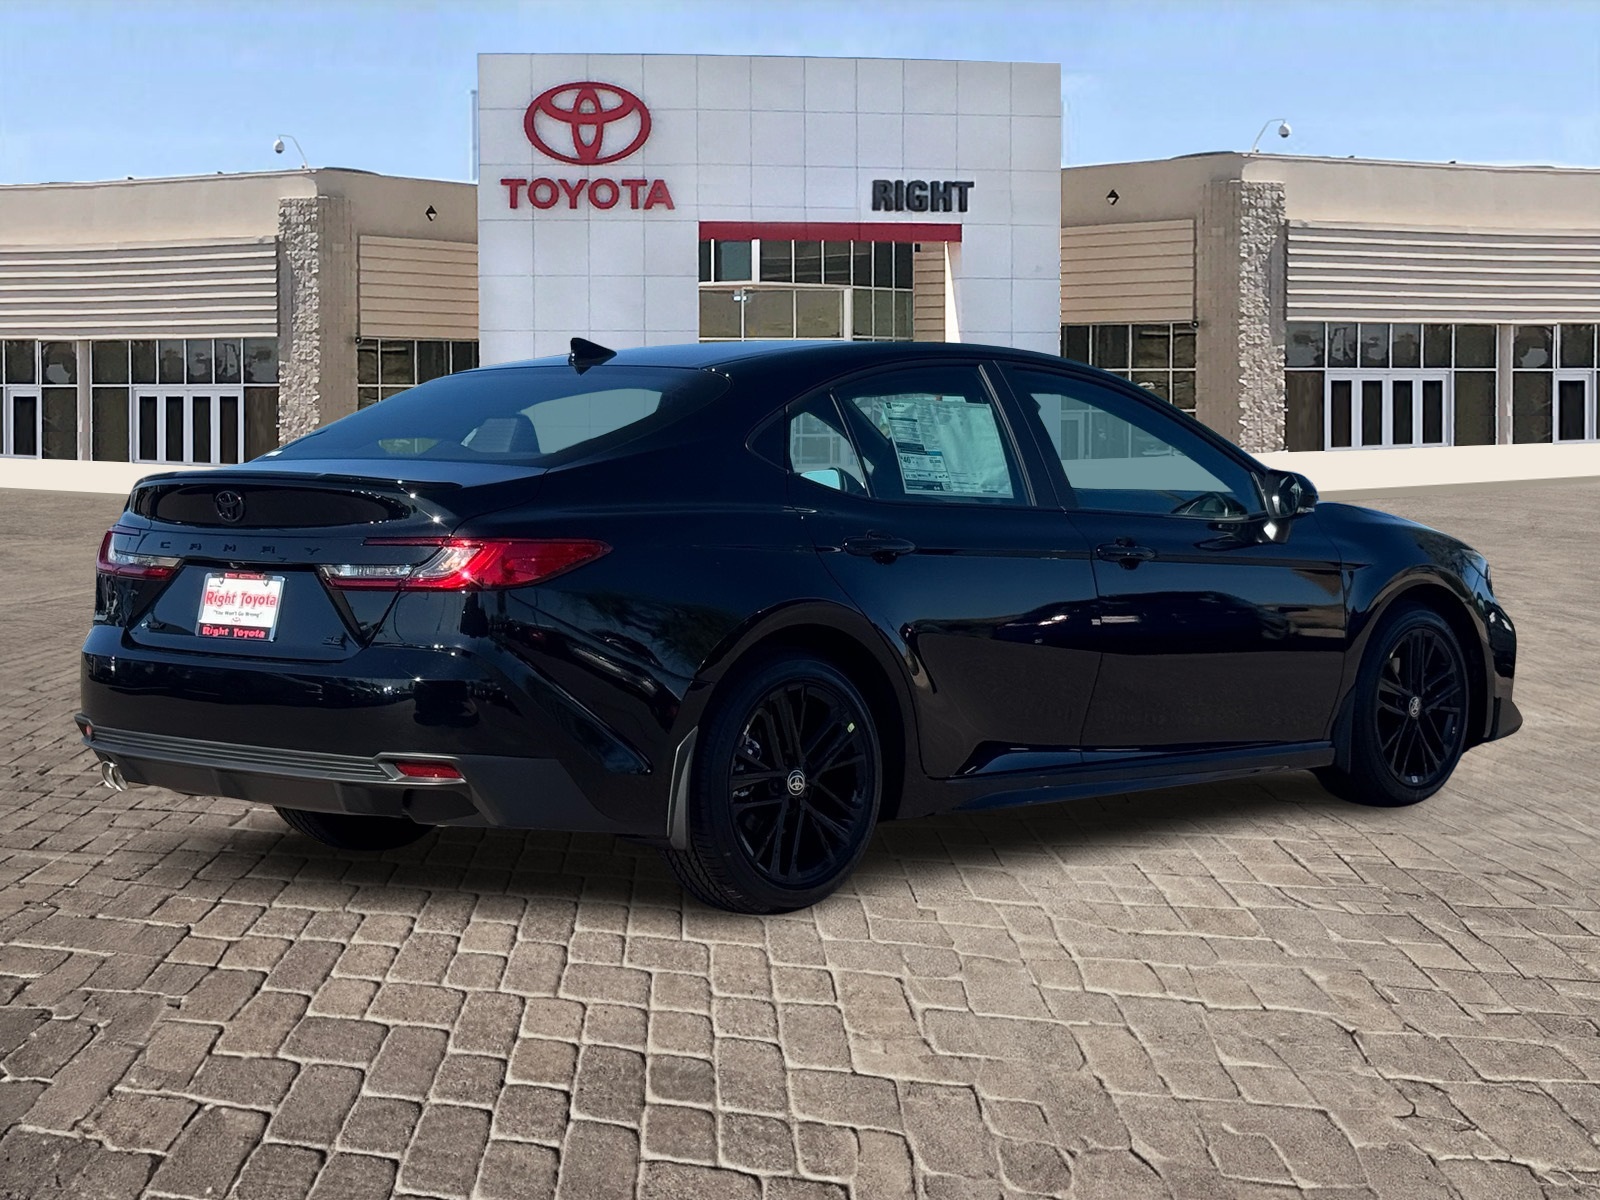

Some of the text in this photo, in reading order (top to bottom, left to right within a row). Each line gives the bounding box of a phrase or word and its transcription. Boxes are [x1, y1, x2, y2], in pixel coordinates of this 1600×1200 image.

[500, 178, 675, 210] TOYOTA
[872, 179, 975, 213] RIGHT
[160, 541, 321, 556] CAMRY
[206, 591, 277, 609] Right Toyota
[202, 626, 266, 639] Right Toyota
